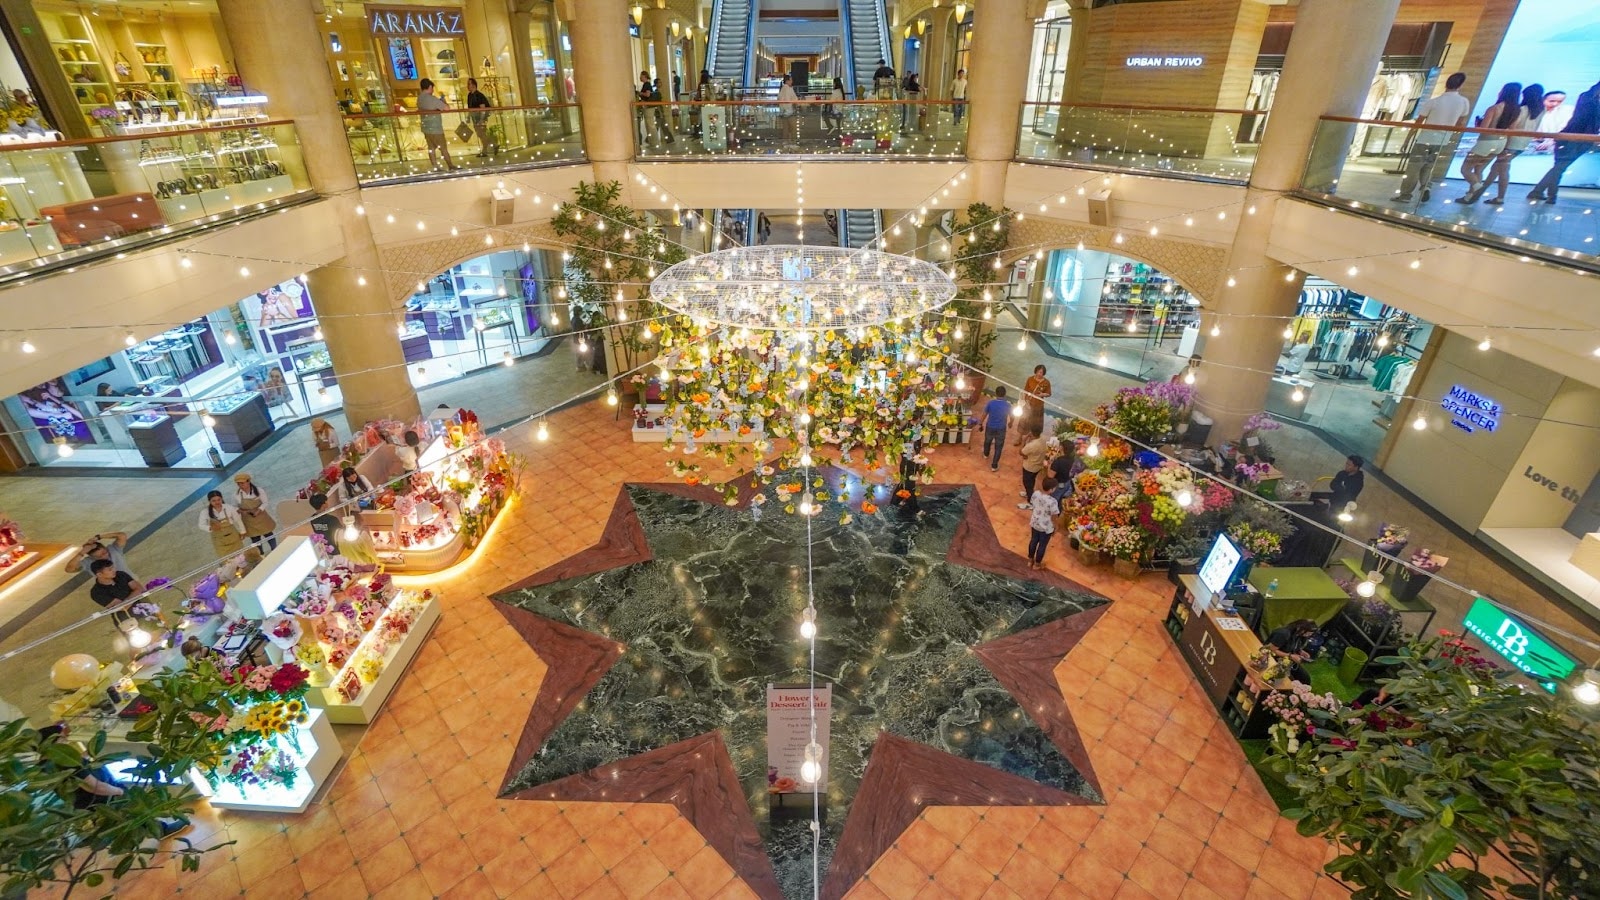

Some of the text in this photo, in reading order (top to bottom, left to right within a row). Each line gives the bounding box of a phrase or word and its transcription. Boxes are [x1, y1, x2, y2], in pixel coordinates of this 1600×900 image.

[1126, 57, 1203, 66] URBAN REVIVO
[1449, 385, 1490, 411] MARKS
[1441, 398, 1495, 432] SPENCER
[1524, 465, 1558, 492] Love
[1465, 620, 1509, 656] DESIGNER
[1496, 618, 1529, 656] DB
